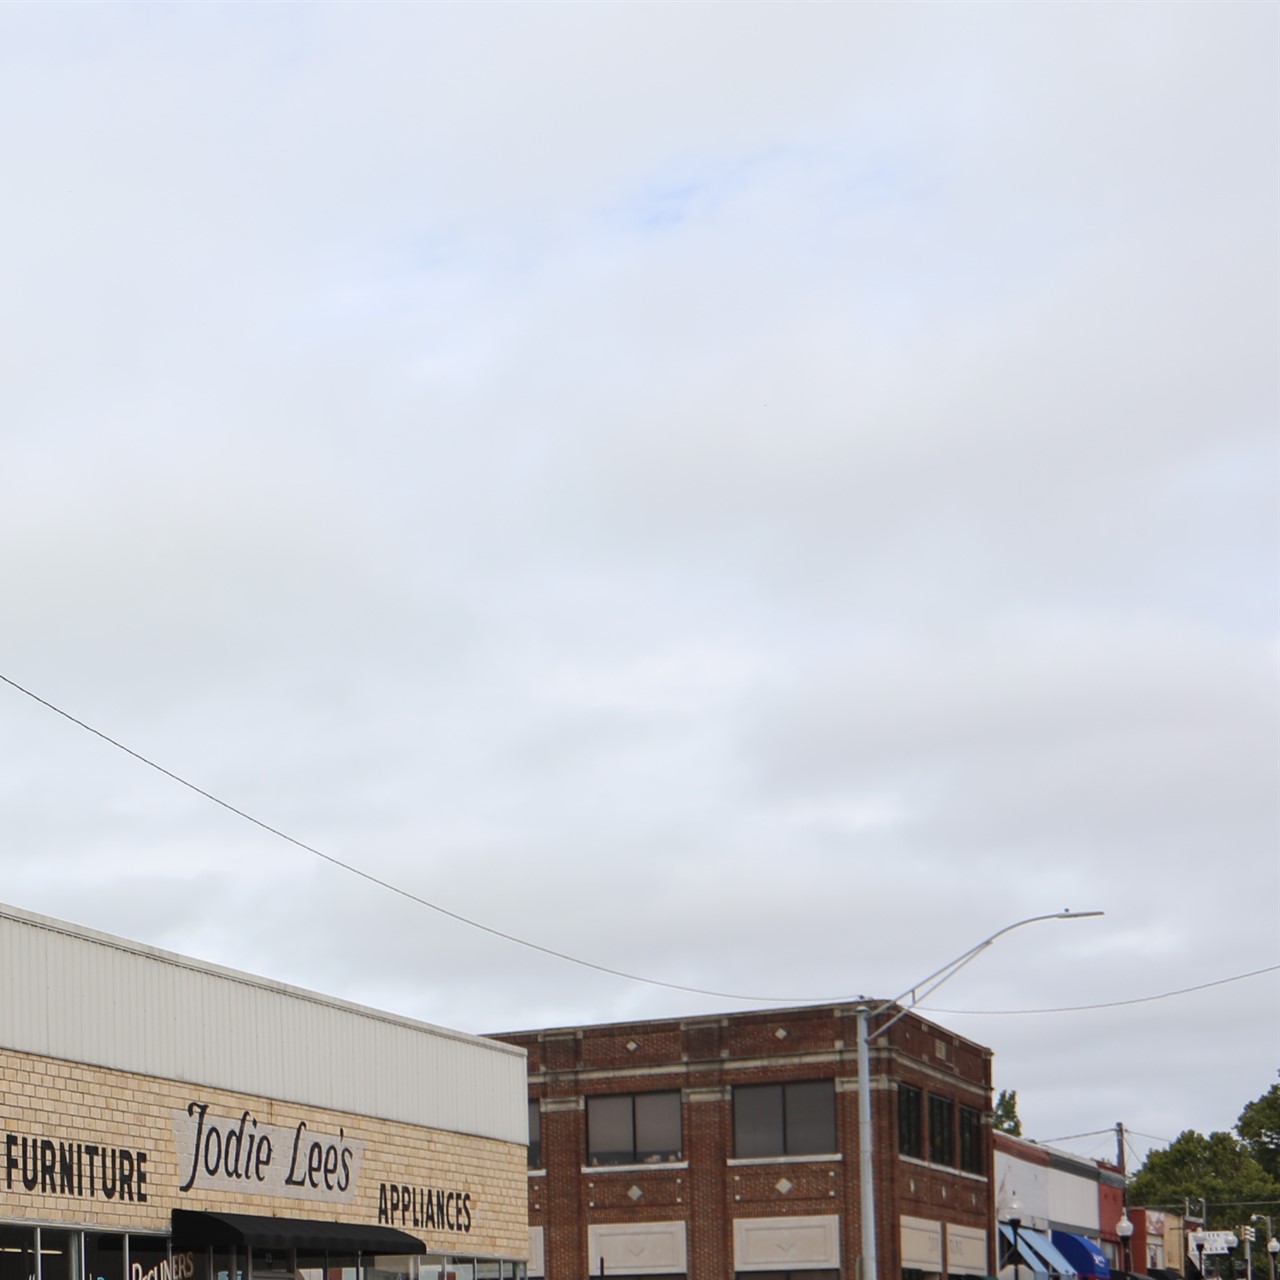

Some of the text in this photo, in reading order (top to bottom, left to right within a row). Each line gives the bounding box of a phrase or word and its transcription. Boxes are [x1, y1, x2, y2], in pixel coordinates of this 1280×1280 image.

[5, 1133, 148, 1203] FURNITURE
[179, 1101, 354, 1193] Jodie Lee's
[377, 1182, 472, 1233] APPLIANCES
